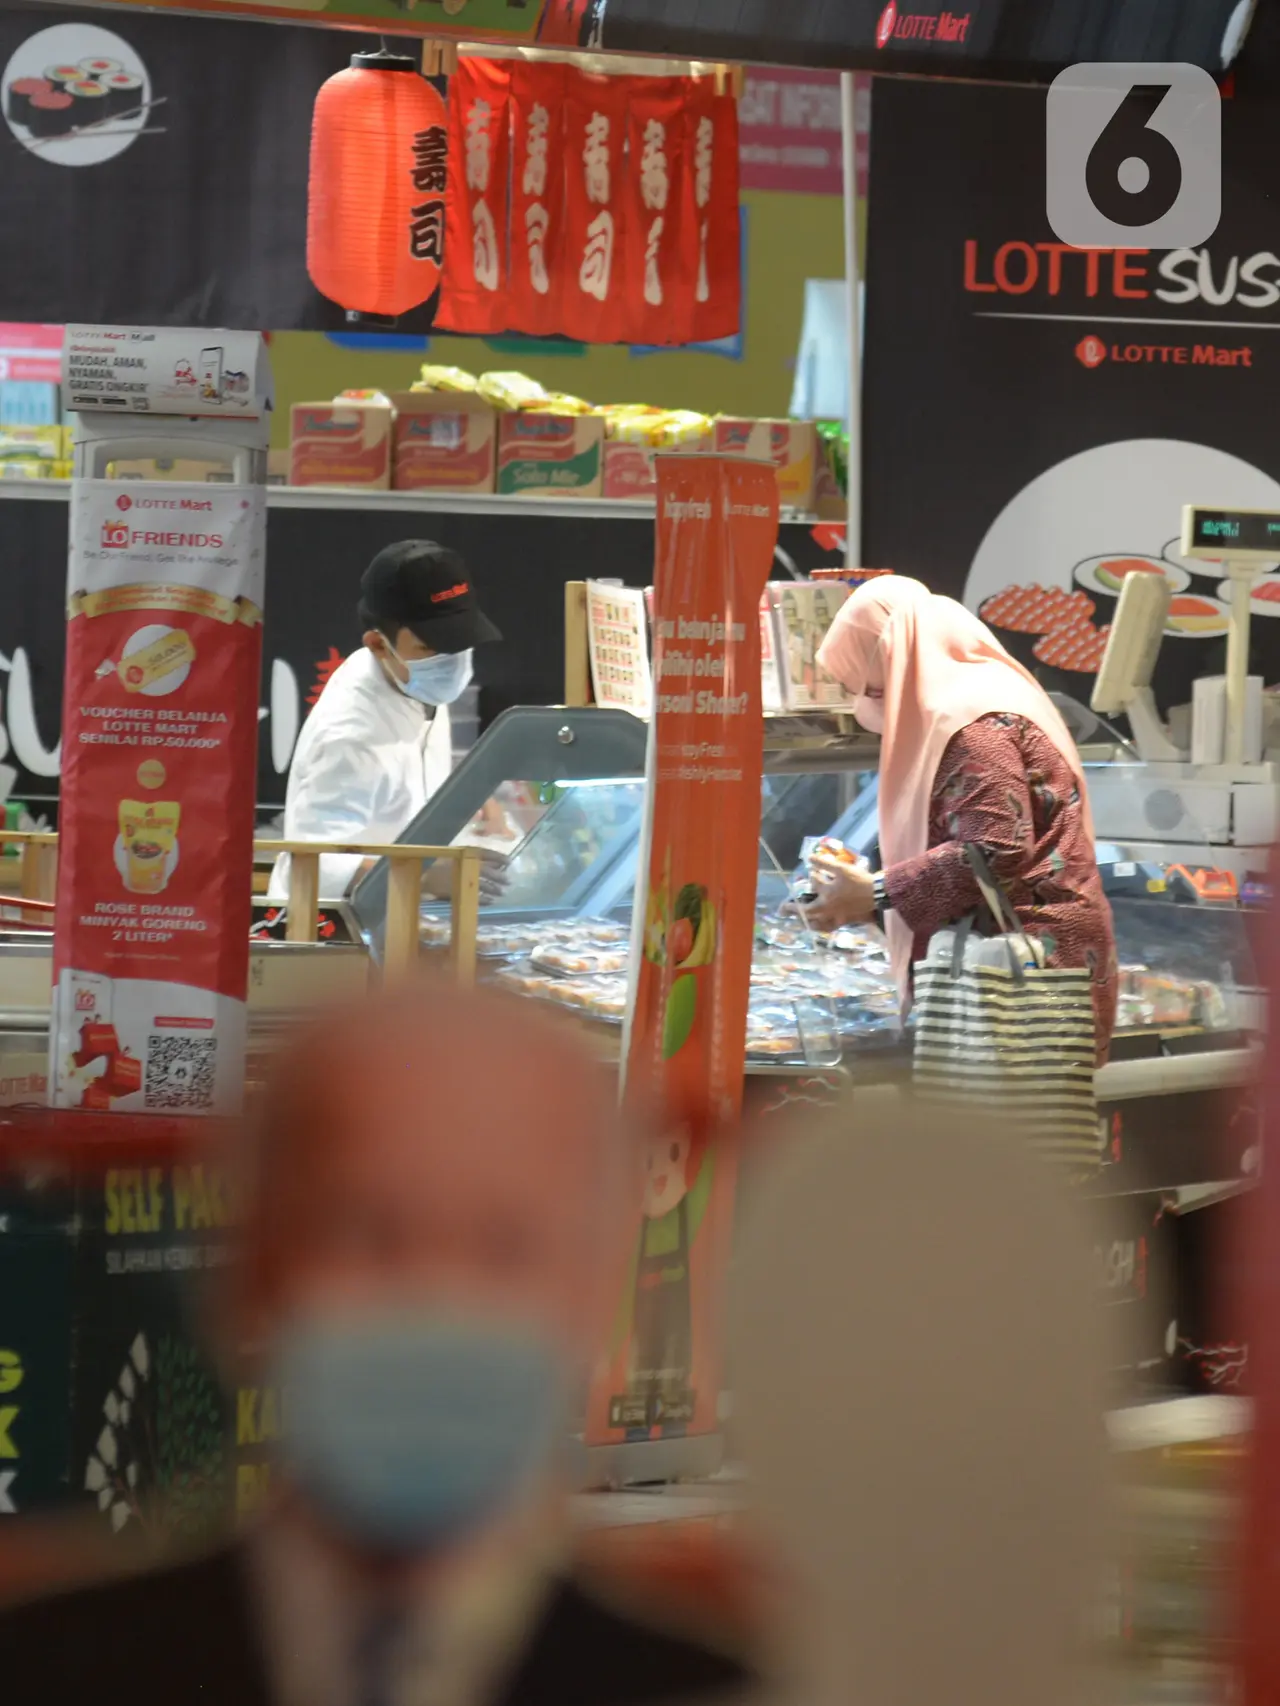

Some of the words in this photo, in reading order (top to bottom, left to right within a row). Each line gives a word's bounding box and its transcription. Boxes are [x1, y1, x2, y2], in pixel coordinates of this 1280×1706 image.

[894, 15, 938, 40] LOTTE
[936, 12, 971, 43] Mart
[964, 239, 1151, 299] LOTTE
[1153, 246, 1280, 308] SUS
[1111, 345, 1188, 364] LOTTE
[1191, 345, 1252, 366] Mart
[135, 499, 177, 511] LOTTE
[179, 499, 213, 512] Mart
[131, 531, 223, 549] FRIENDS
[80, 706, 154, 720] VOUCHER
[157, 709, 229, 723] BELANJA
[102, 720, 152, 733] LOTTE
[155, 723, 199, 735] MART
[95, 902, 137, 914] ROSE
[140, 904, 195, 917] BRAND
[79, 915, 138, 928] MINYAK
[142, 917, 207, 931] GORENG
[112, 931, 122, 941] 2
[105, 1167, 163, 1234] SELF
